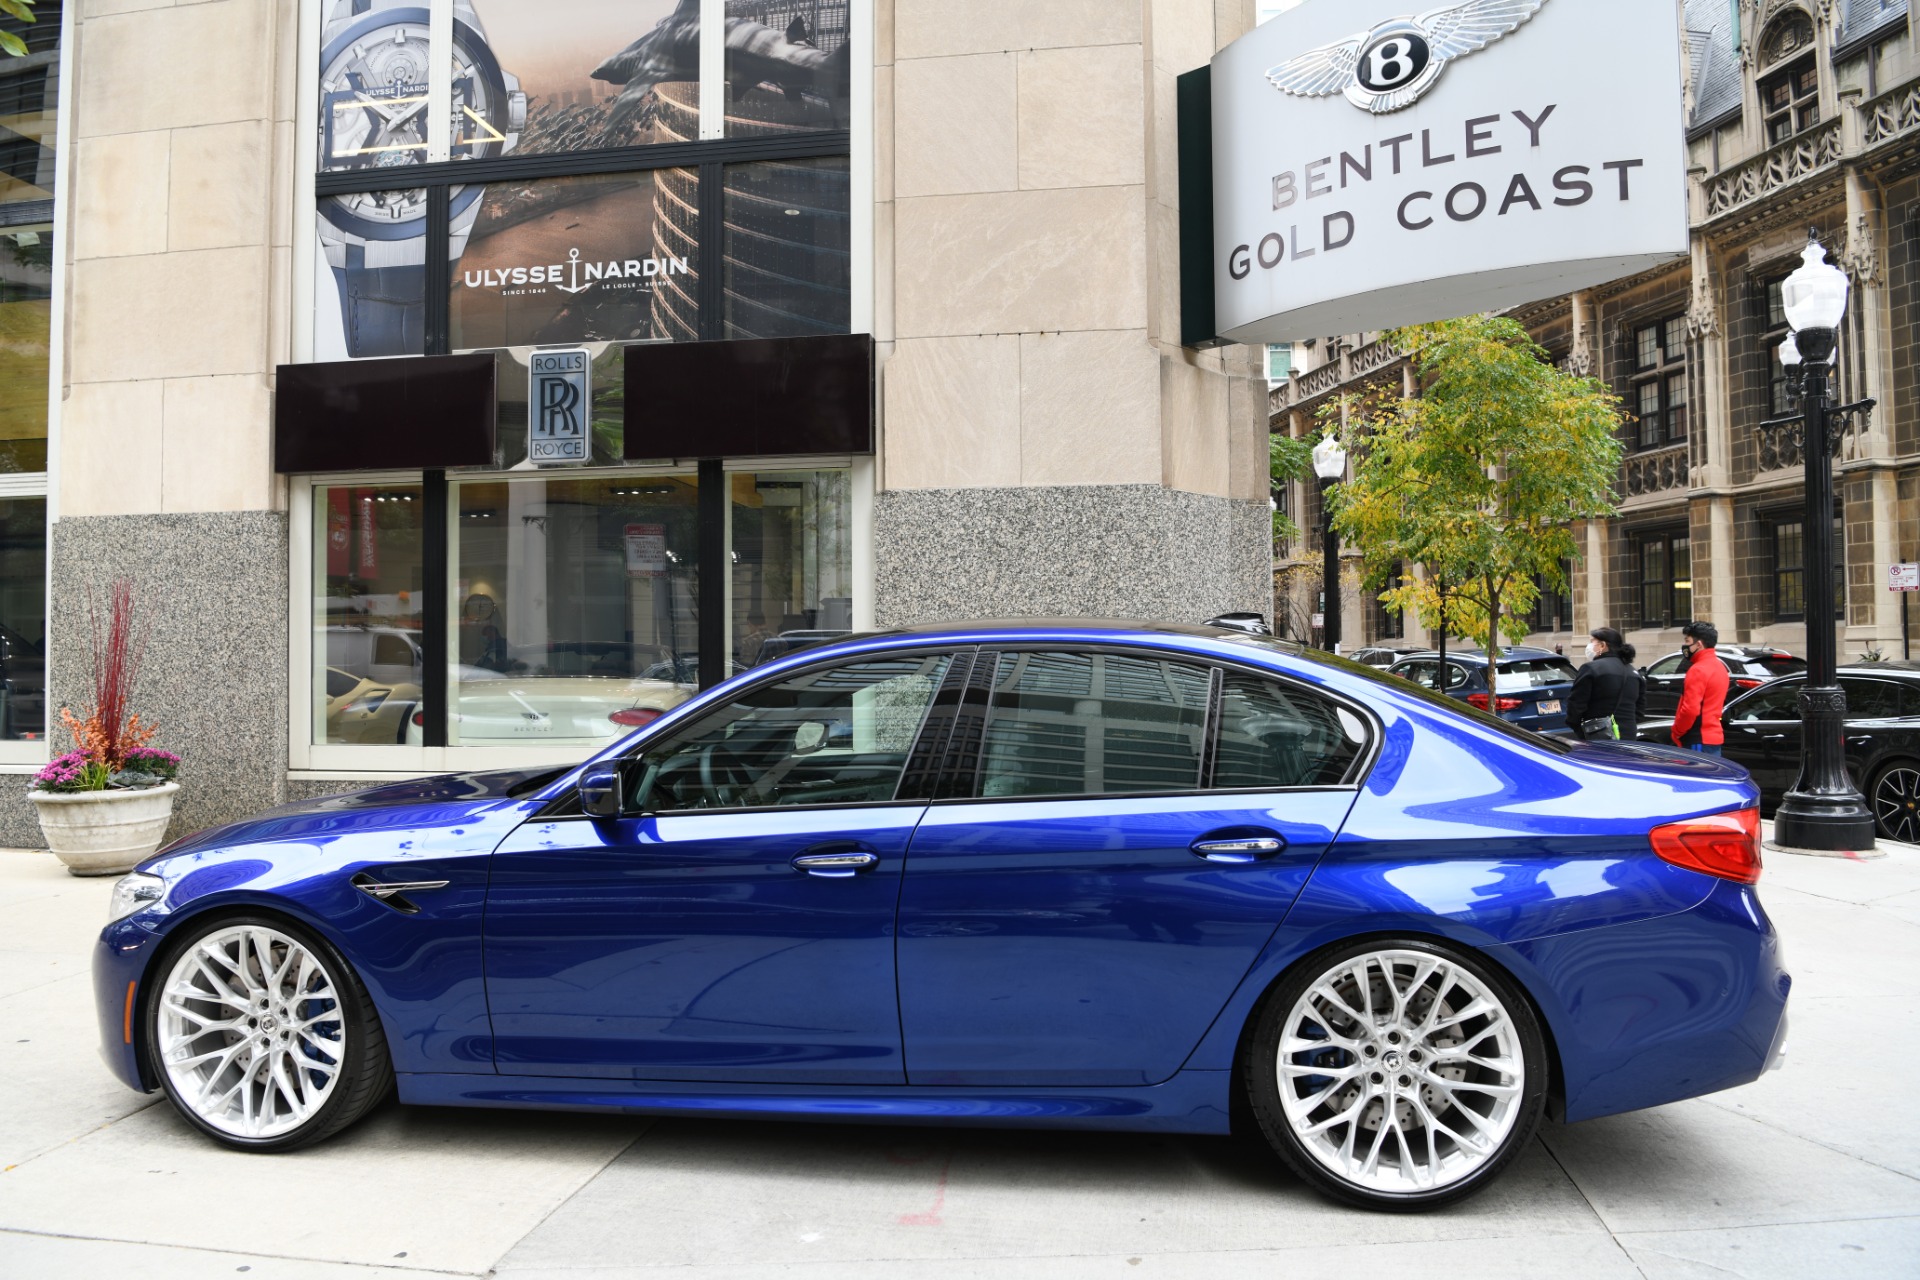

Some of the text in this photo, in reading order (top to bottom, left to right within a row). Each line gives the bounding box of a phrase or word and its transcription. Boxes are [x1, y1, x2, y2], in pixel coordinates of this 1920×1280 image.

[1367, 37, 1414, 86] B
[366, 84, 428, 96] ULYSSE NARDI
[1272, 104, 1557, 211] BENTLEY
[1229, 159, 1643, 281] GOLD COAST
[465, 257, 688, 288] ULYSSE NARDIN
[535, 356, 582, 371] ROLLS
[534, 442, 582, 456] ROYCE
